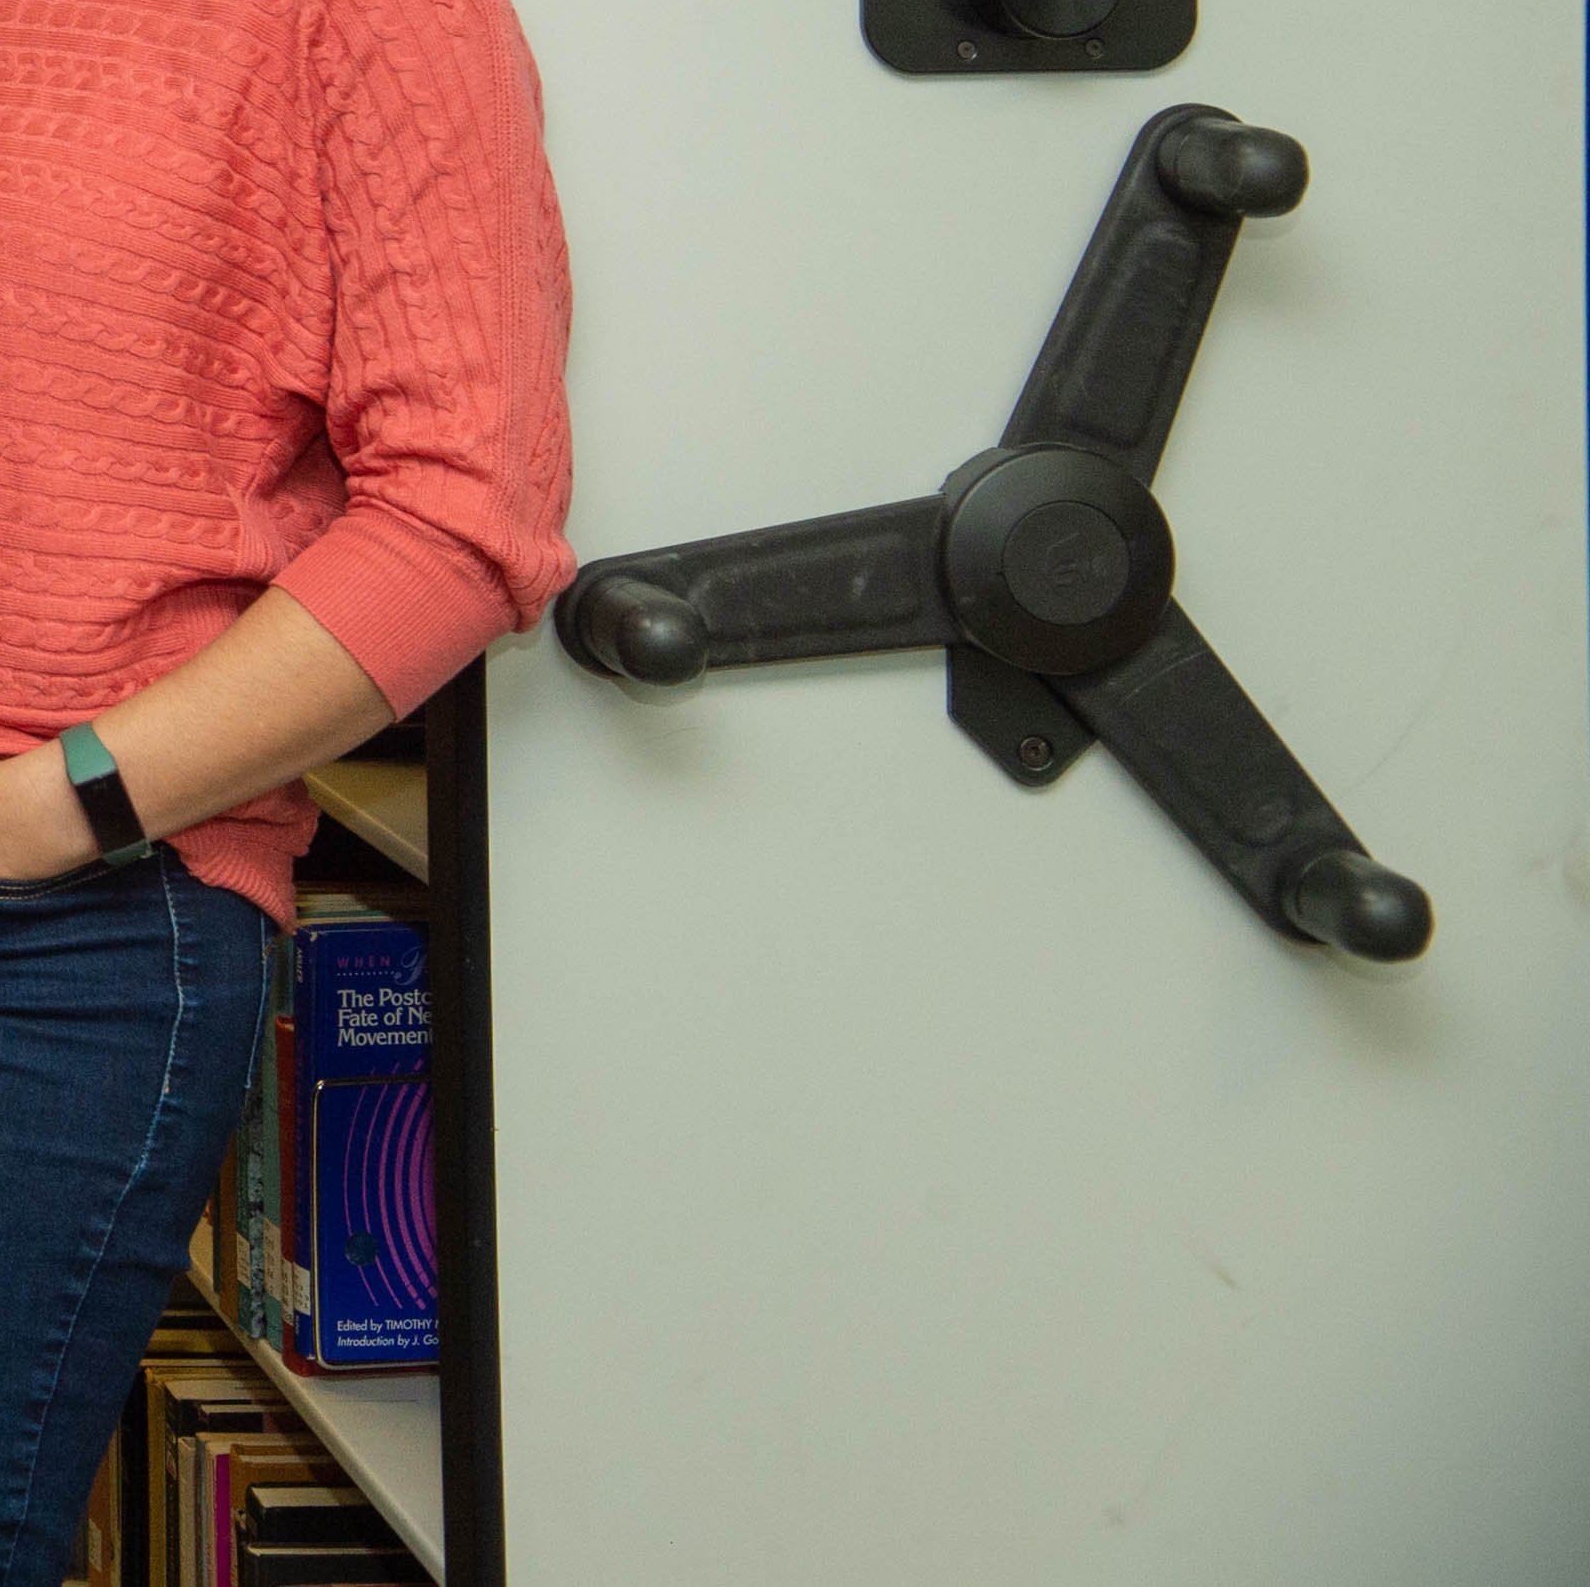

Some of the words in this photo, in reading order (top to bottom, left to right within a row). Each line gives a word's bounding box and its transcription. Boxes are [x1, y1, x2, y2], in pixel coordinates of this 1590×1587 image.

[336, 955, 391, 968] WHEN
[337, 989, 375, 1008] The
[337, 1008, 379, 1028] Fate
[383, 1006, 404, 1026] of
[336, 1318, 368, 1332] Edited
[369, 1318, 383, 1333] by
[384, 1318, 433, 1331] TIMOTHY
[336, 1334, 395, 1348] Introduction
[396, 1333, 410, 1349] by
